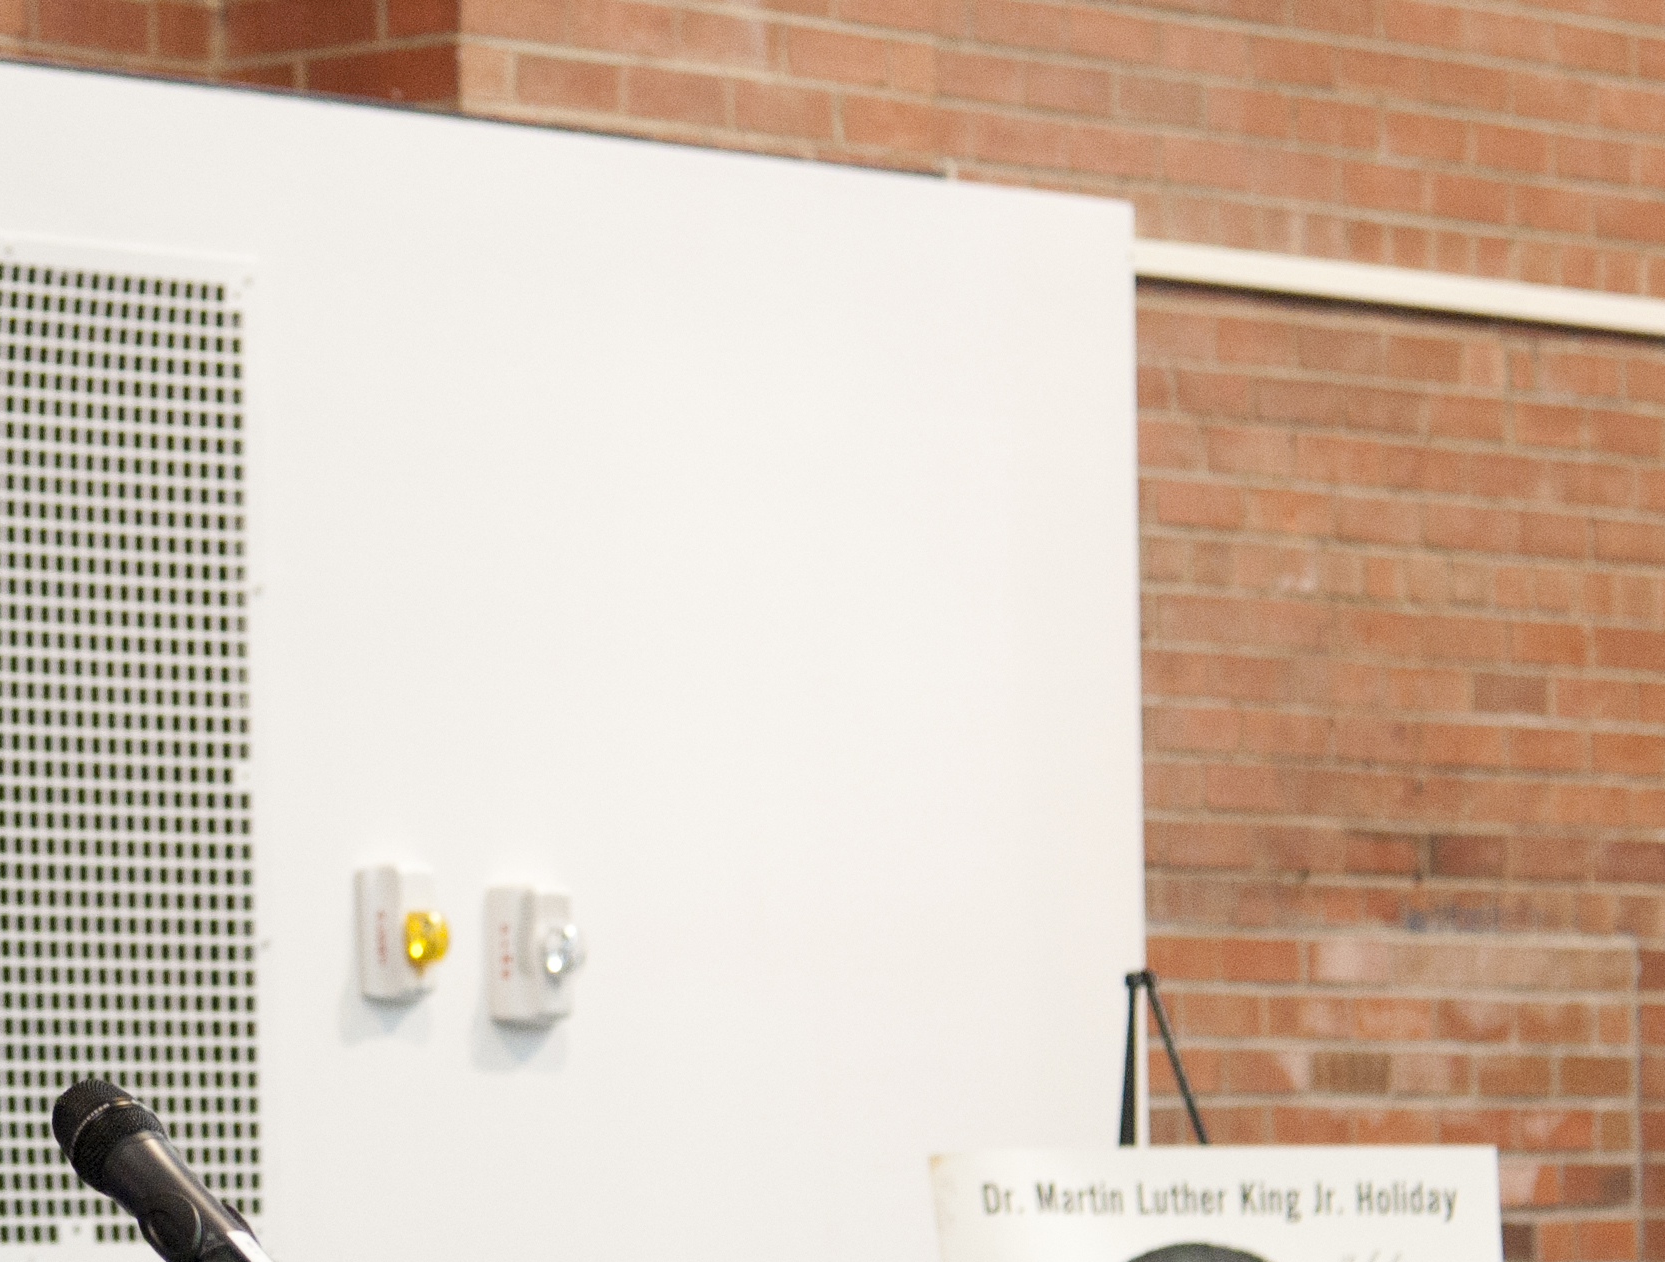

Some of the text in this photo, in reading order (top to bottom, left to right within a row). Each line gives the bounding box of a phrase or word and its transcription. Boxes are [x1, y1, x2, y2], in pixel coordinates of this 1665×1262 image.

[981, 1179, 1458, 1224] Dr. Martin Luther King Jr. Holiday
